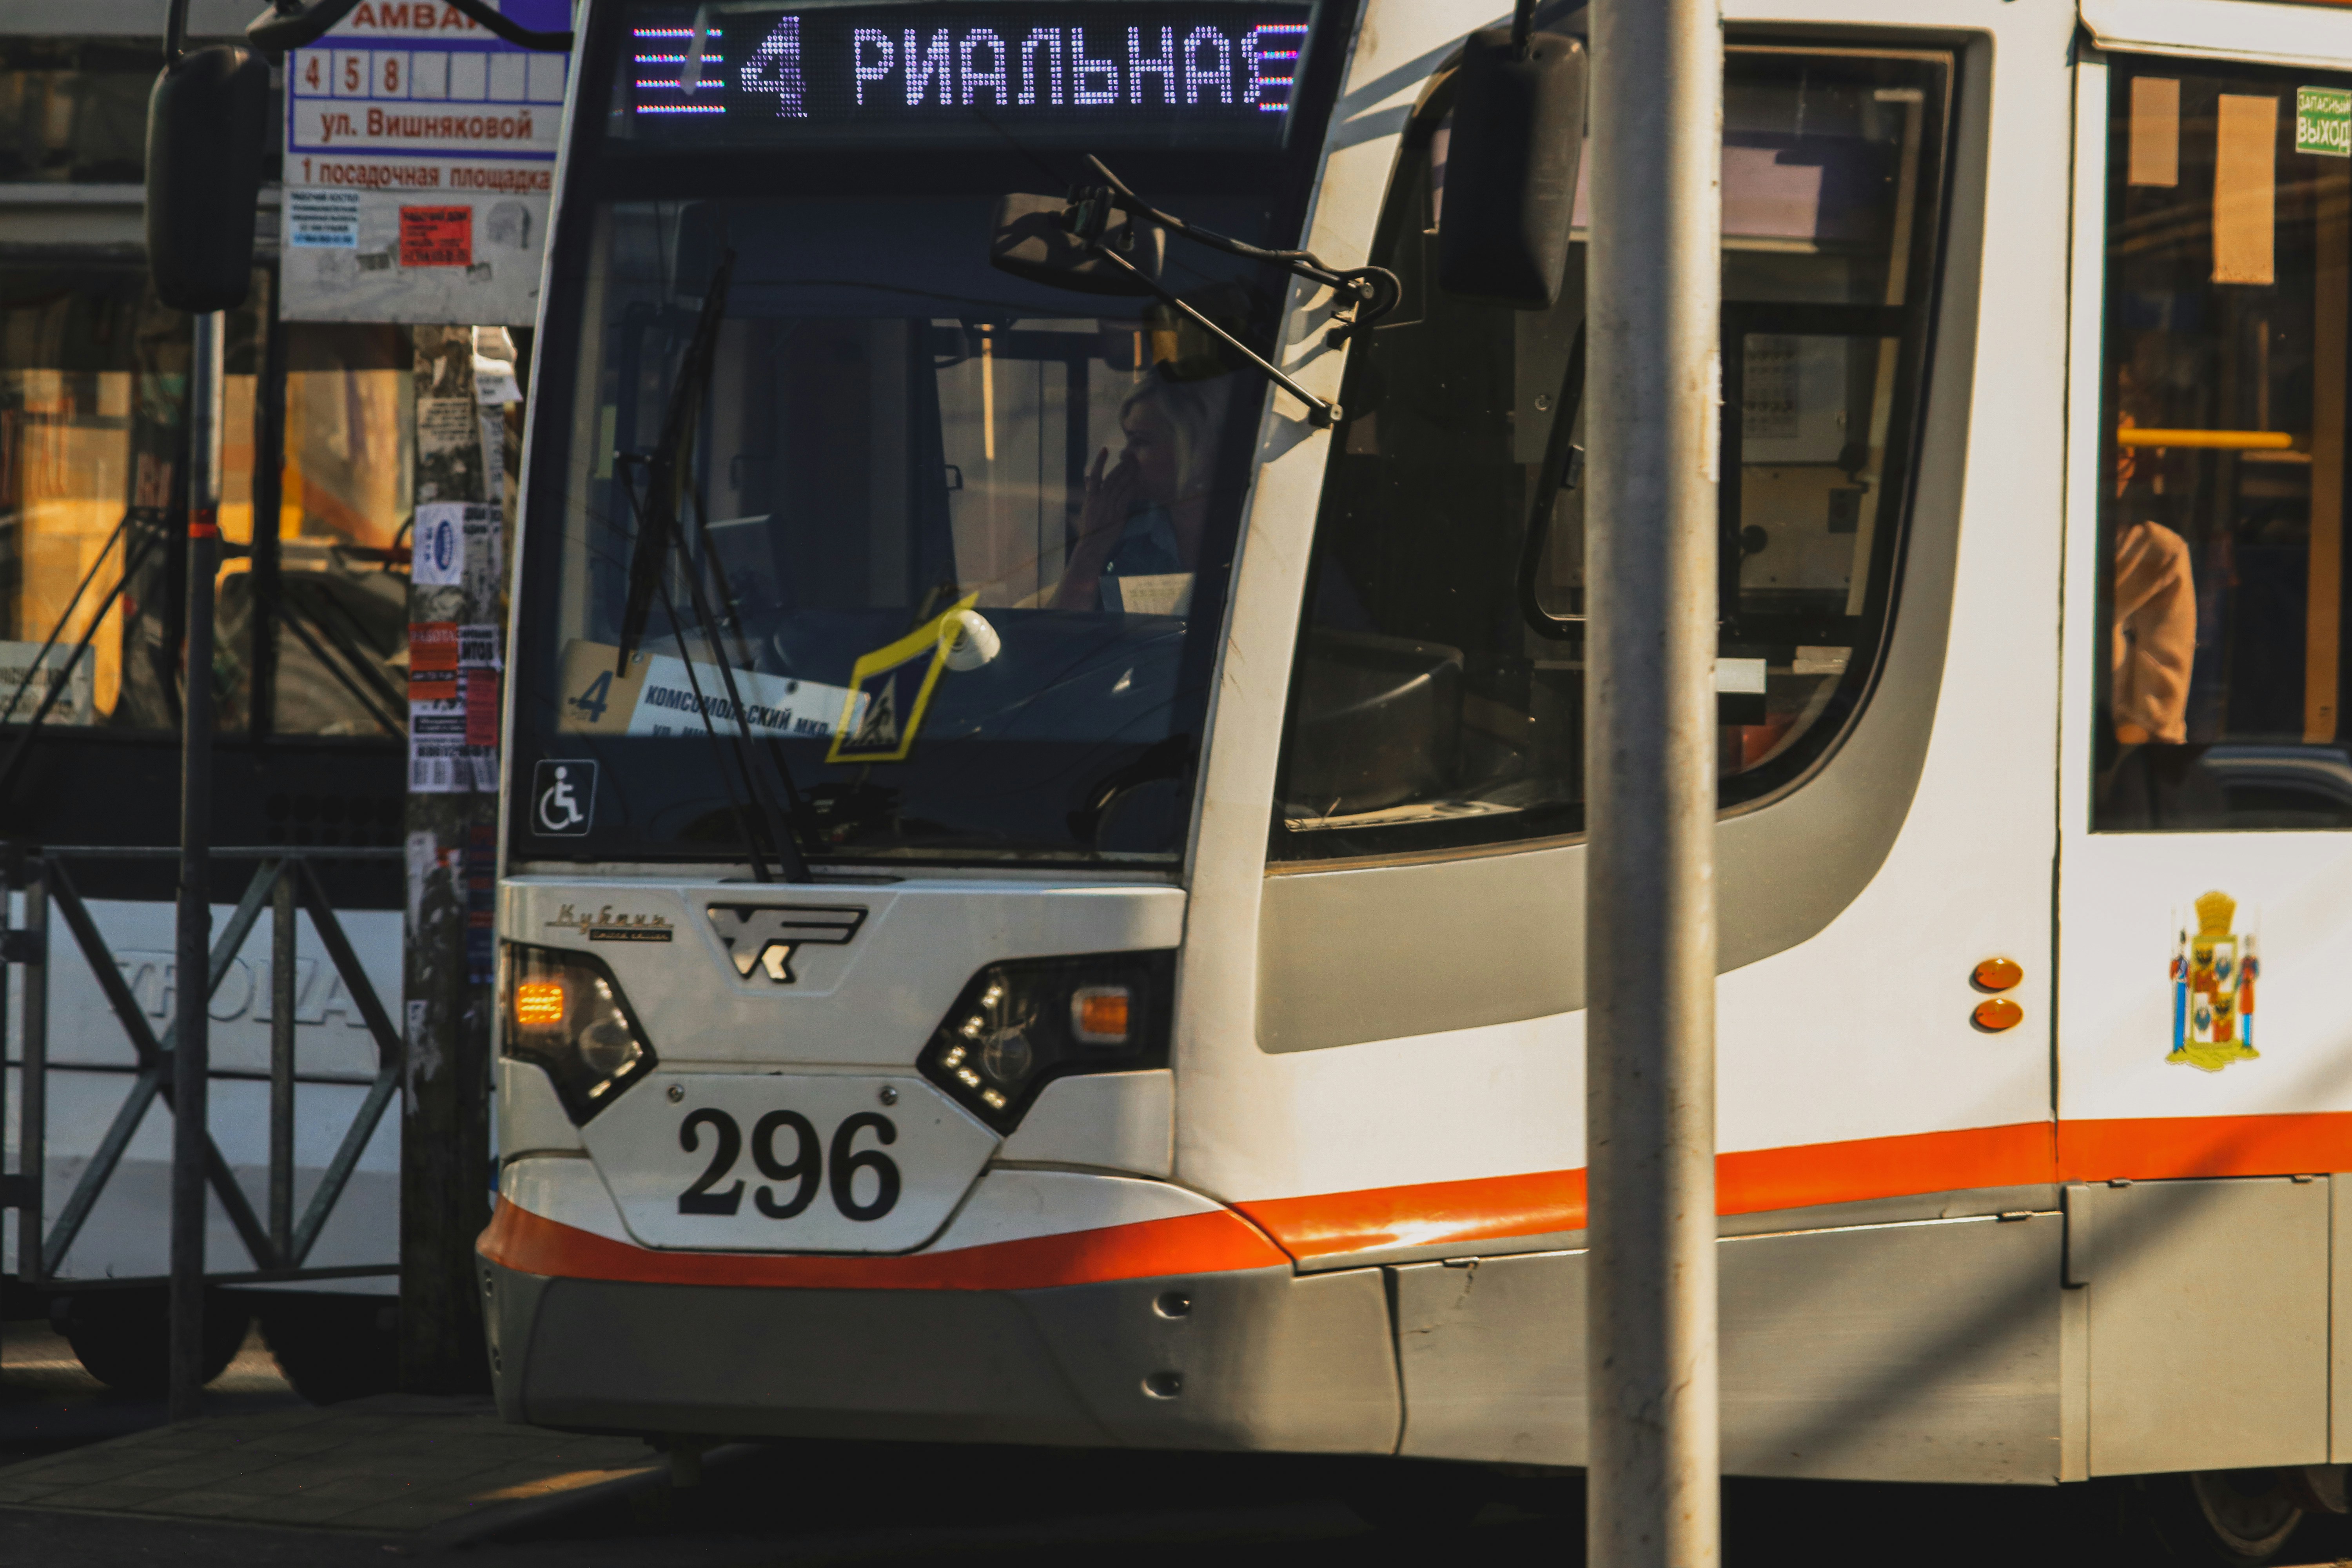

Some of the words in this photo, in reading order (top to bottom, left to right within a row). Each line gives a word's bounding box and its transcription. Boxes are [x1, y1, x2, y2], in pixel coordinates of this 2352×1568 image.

[354, 2, 477, 29] АМВА
[305, 56, 319, 90] 4
[345, 57, 360, 91] 5
[384, 58, 399, 93] 8
[740, 16, 808, 118] 4
[321, 112, 357, 143] ул.
[367, 107, 532, 139] Вишняковой
[2298, 117, 2350, 151] ВЫХОД
[302, 158, 311, 182] 1
[319, 162, 440, 188] посадочная
[450, 166, 550, 193] площадка
[577, 670, 613, 722] 4
[678, 1107, 901, 1222] 296
